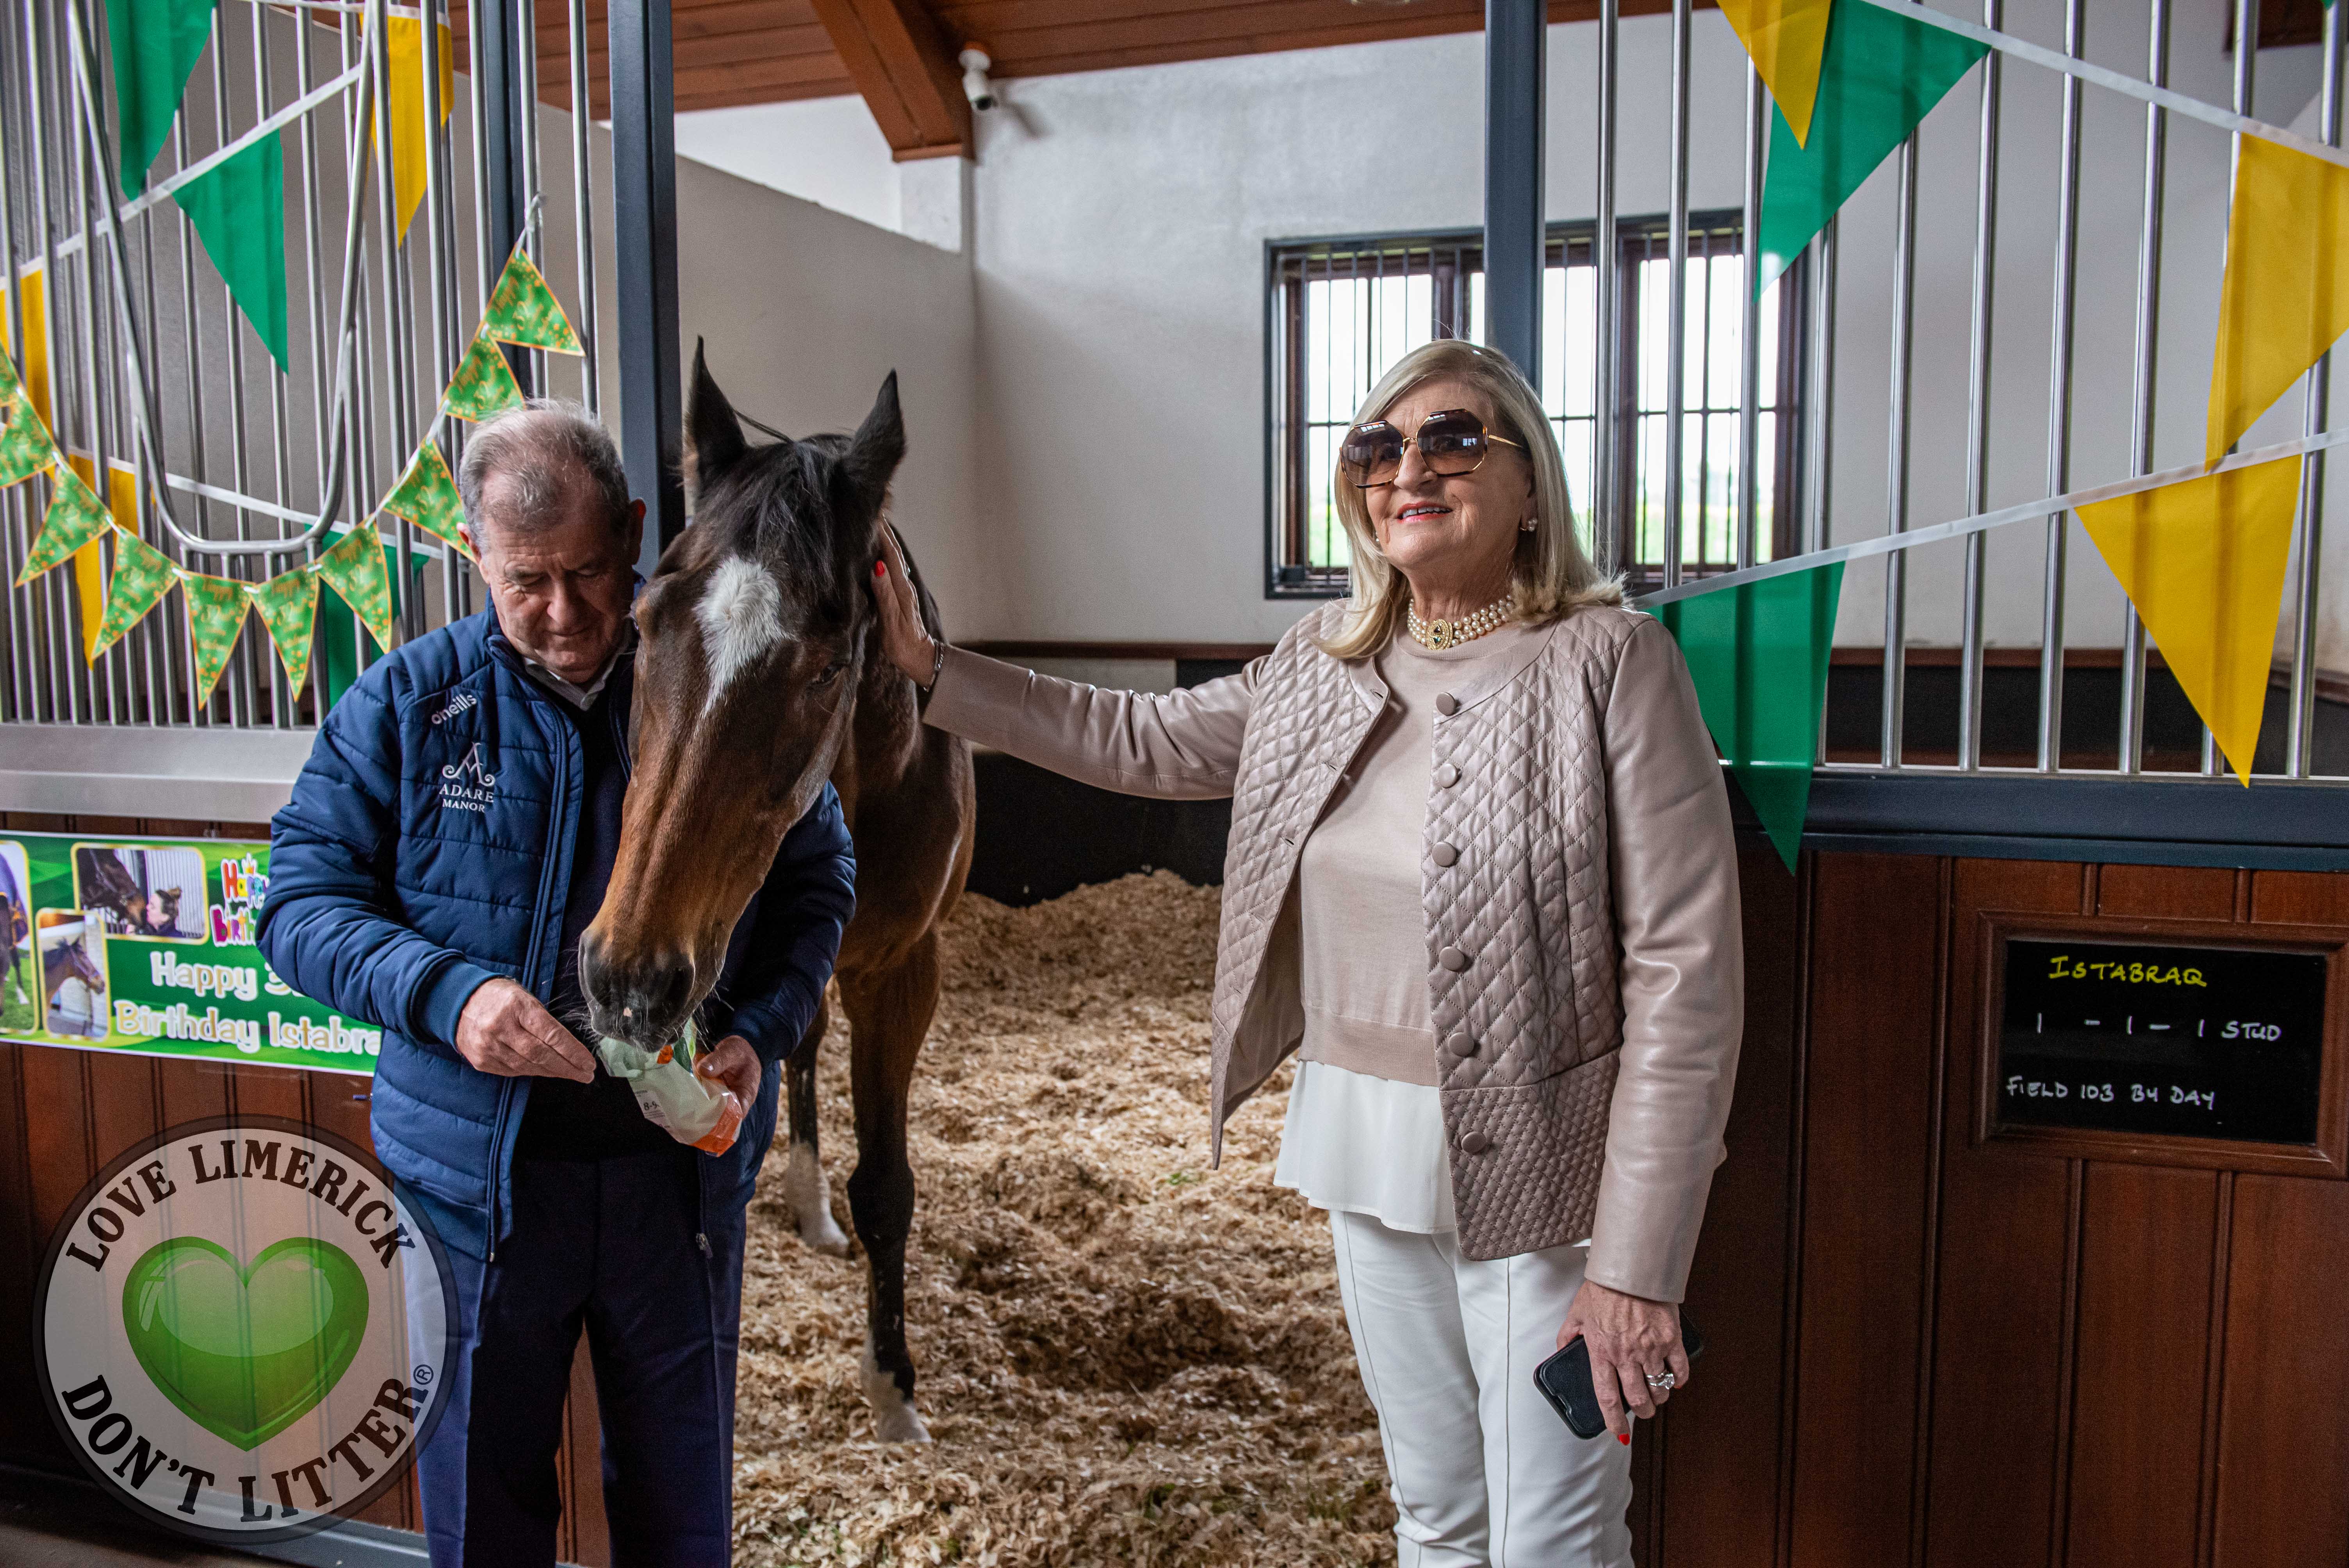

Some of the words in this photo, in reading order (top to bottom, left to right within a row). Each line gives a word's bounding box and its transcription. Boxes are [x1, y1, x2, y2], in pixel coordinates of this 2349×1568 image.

[439, 784, 494, 803] ADARE
[442, 798, 485, 813] MANOR
[151, 951, 257, 1001] Happy
[2048, 955, 2207, 987] ISTABRAQ
[114, 1000, 260, 1053] Birthday
[2221, 1020, 2281, 1041] STUD
[2006, 1075, 2068, 1098] FIELD
[2081, 1083, 2114, 1102] 103
[2170, 1085, 2215, 1110] DAY
